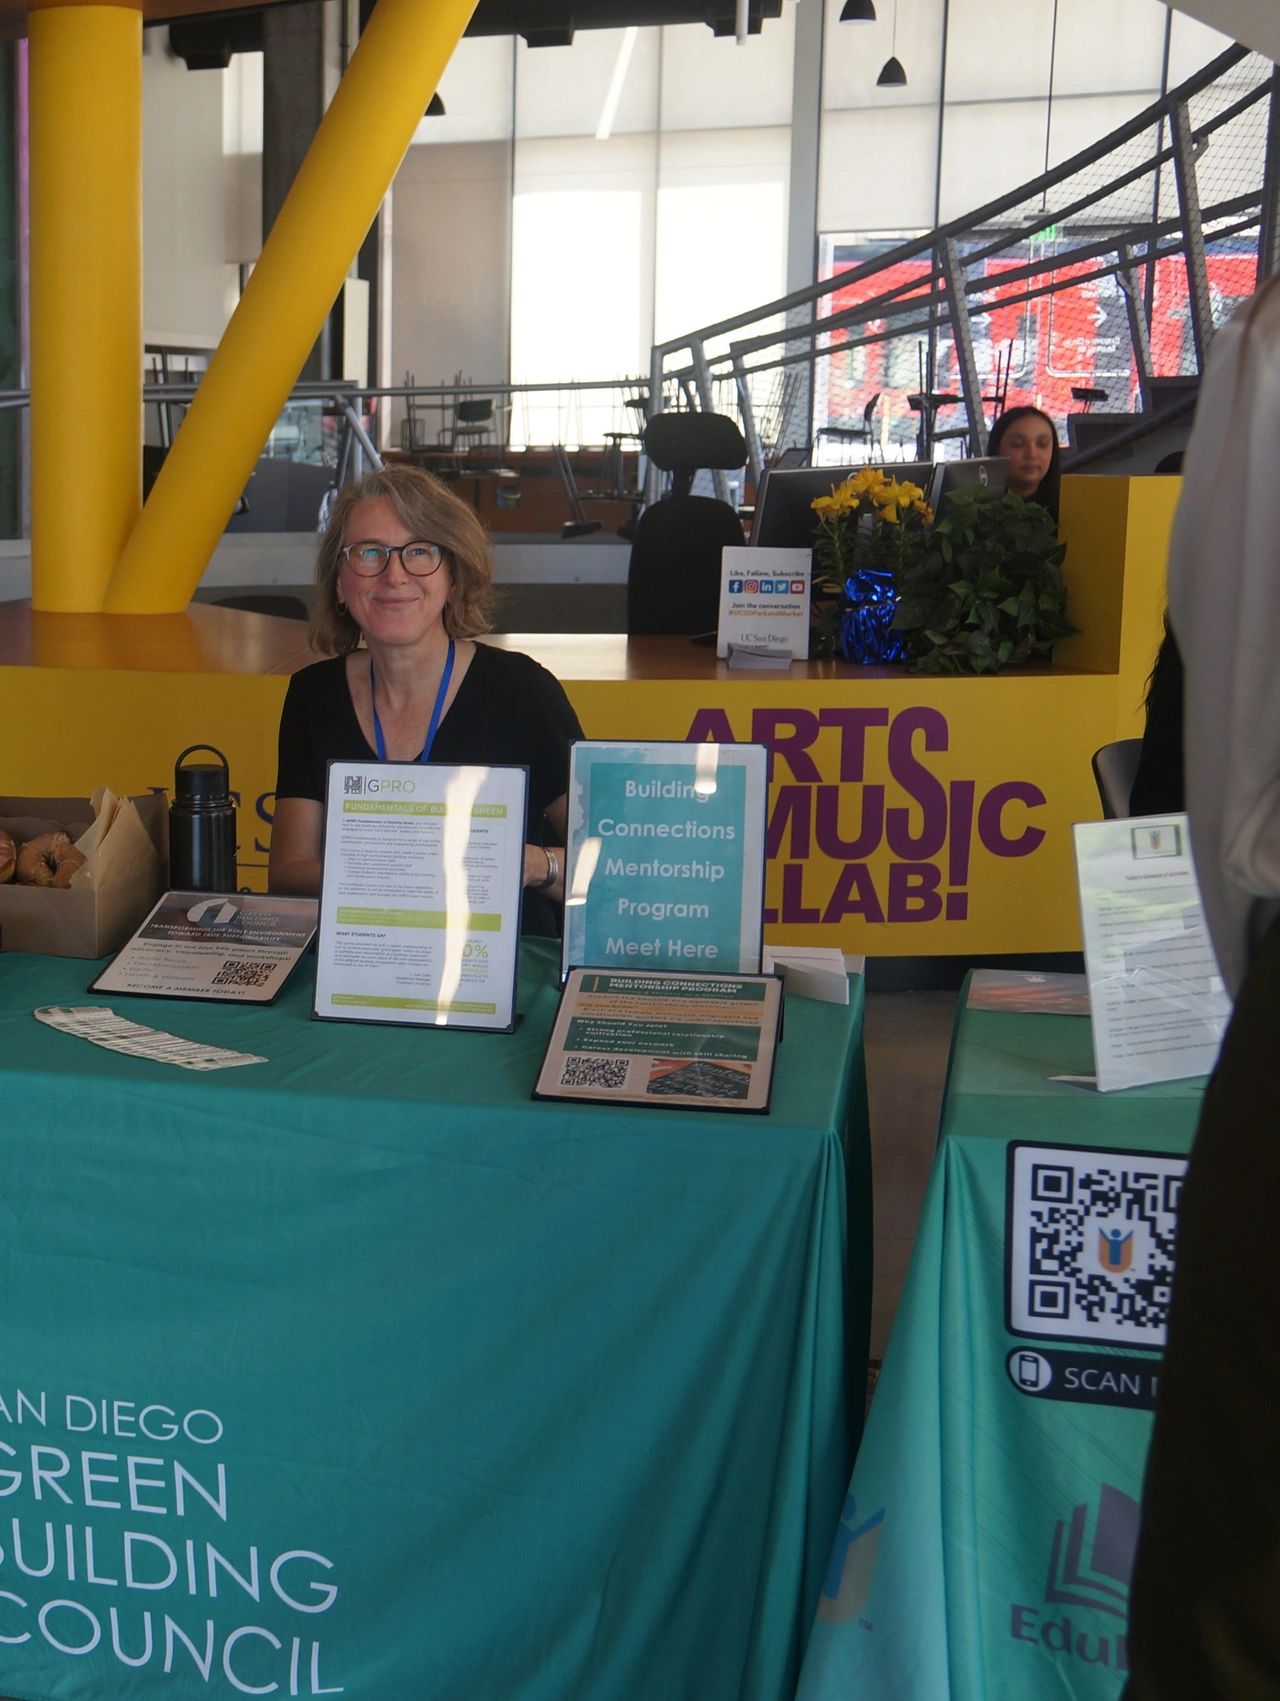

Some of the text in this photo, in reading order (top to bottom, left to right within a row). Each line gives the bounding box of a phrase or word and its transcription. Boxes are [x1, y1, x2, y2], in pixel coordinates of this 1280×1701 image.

[367, 779, 416, 793] GPRO
[625, 780, 710, 803] Building
[598, 818, 735, 840] Connections
[604, 858, 725, 882] Mentorship
[618, 898, 709, 920] Program
[150, 923, 211, 932] TRANSFORMING
[248, 929, 306, 937] ENVIRONMENT
[463, 943, 488, 958] 0%
[605, 936, 718, 958] Meet Here
[608, 983, 738, 993] MENTORSHIP PROGRAM
[610, 978, 743, 989] BUILDING CONNECTIONS
[1064, 1368, 1140, 1395] SCAN
[65, 1394, 224, 1444] DIEGO
